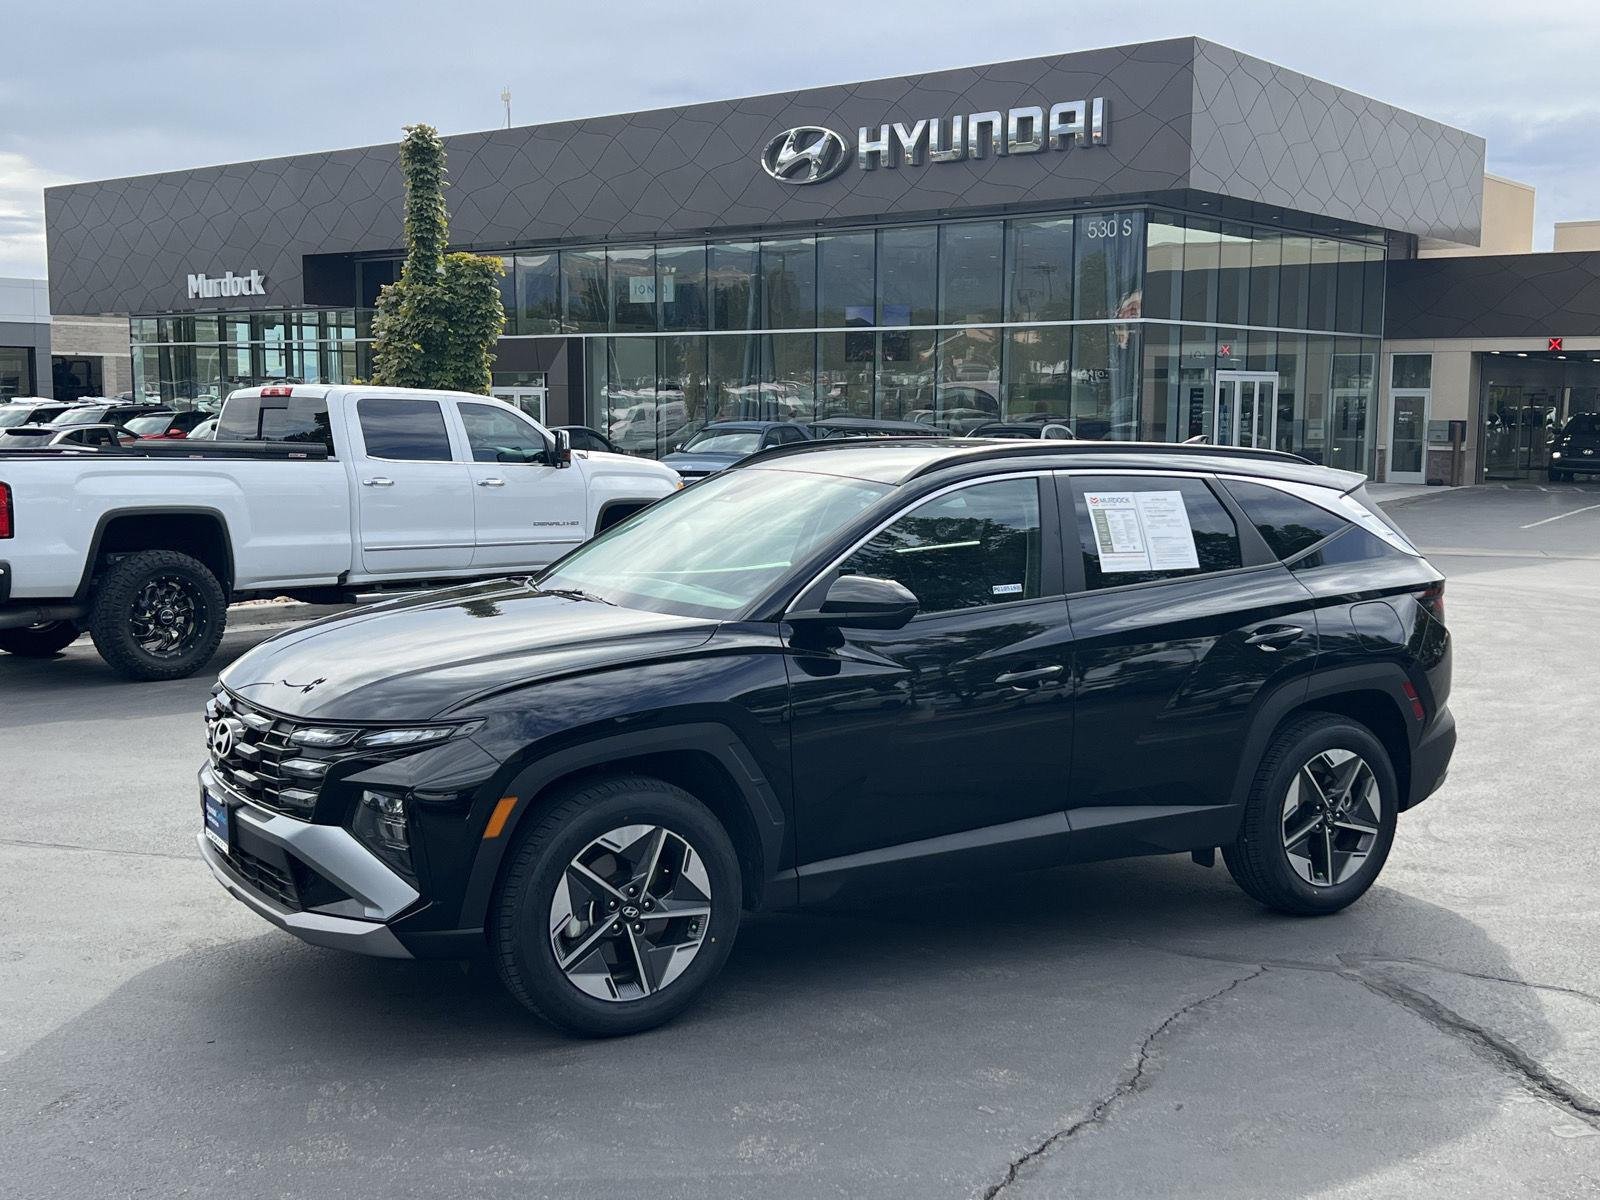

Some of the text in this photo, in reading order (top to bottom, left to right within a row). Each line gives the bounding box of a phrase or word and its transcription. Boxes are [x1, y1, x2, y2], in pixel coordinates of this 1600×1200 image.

[858, 97, 1107, 170] HYUNDAI
[1087, 219, 1132, 239] 530 S
[187, 269, 266, 299] Murdock
